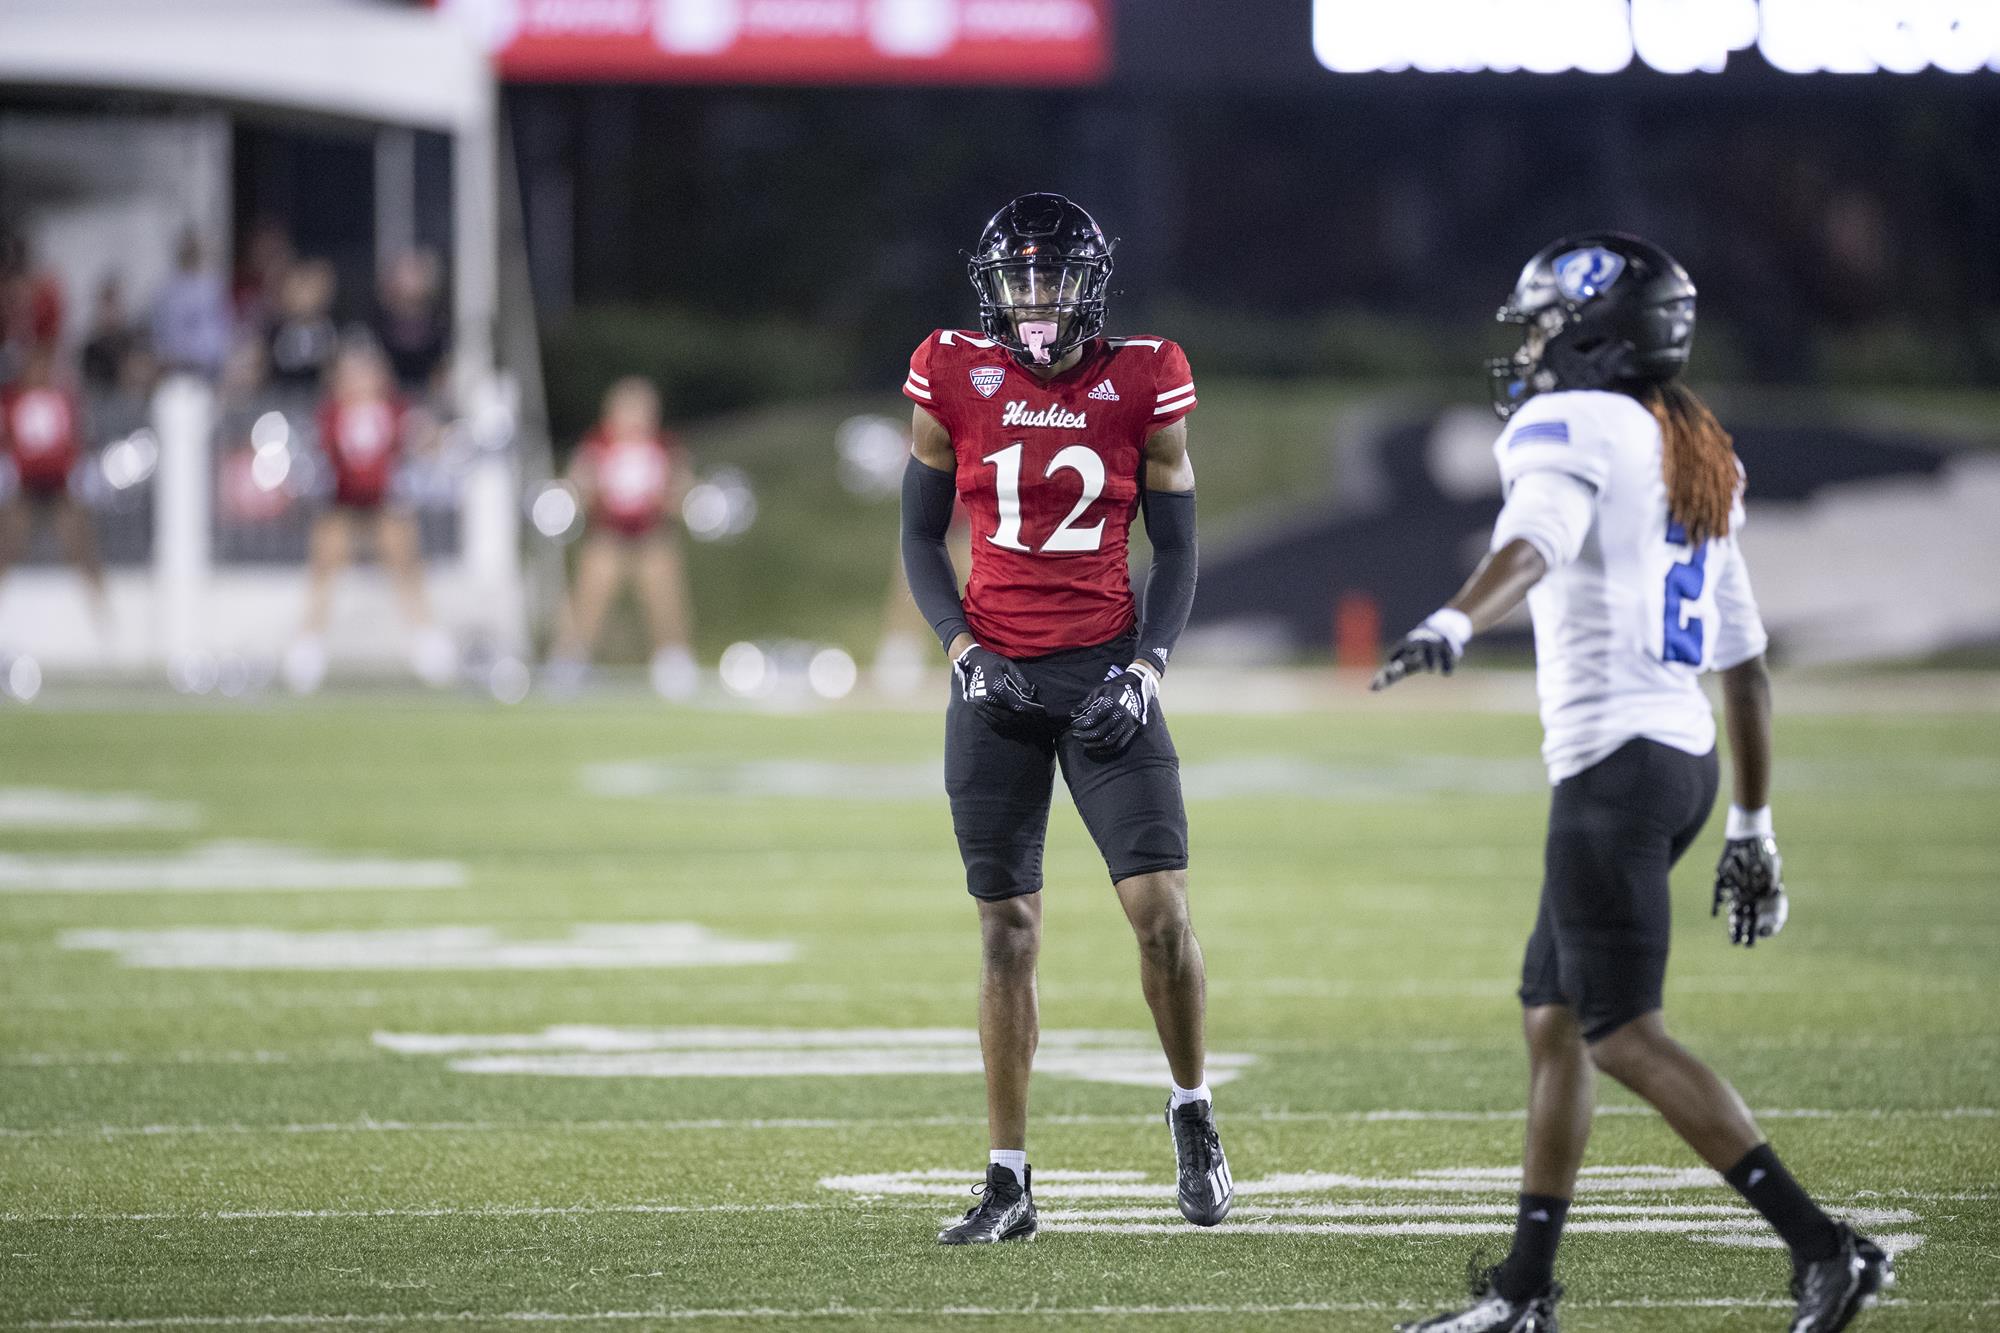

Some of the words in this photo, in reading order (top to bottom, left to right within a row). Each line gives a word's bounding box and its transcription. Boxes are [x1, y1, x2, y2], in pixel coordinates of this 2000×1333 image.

[973, 375, 1002, 385] MAC
[1088, 391, 1120, 401] adidas
[1003, 401, 1087, 429] Huskies
[982, 441, 1107, 553] 12
[1662, 512, 1708, 666] 2
